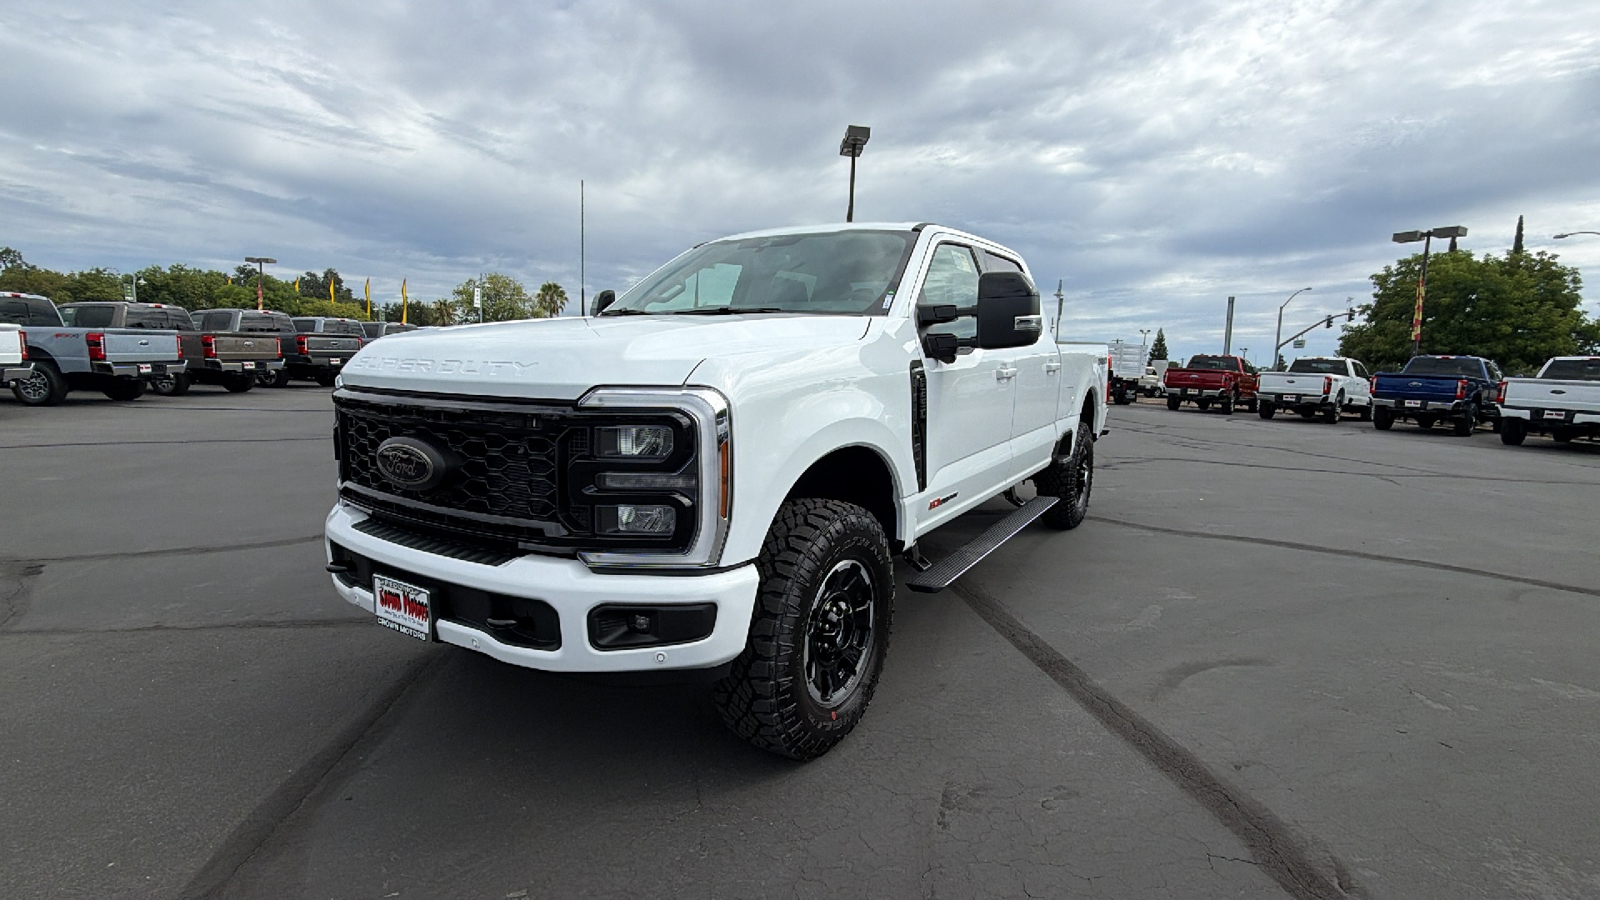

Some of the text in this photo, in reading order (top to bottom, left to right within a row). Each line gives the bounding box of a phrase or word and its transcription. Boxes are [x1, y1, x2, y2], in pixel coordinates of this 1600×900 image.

[354, 356, 539, 377] SUPER DUTY
[386, 451, 417, 476] Ford
[377, 618, 399, 631] CROWN
[399, 625, 426, 641] MOTORS
